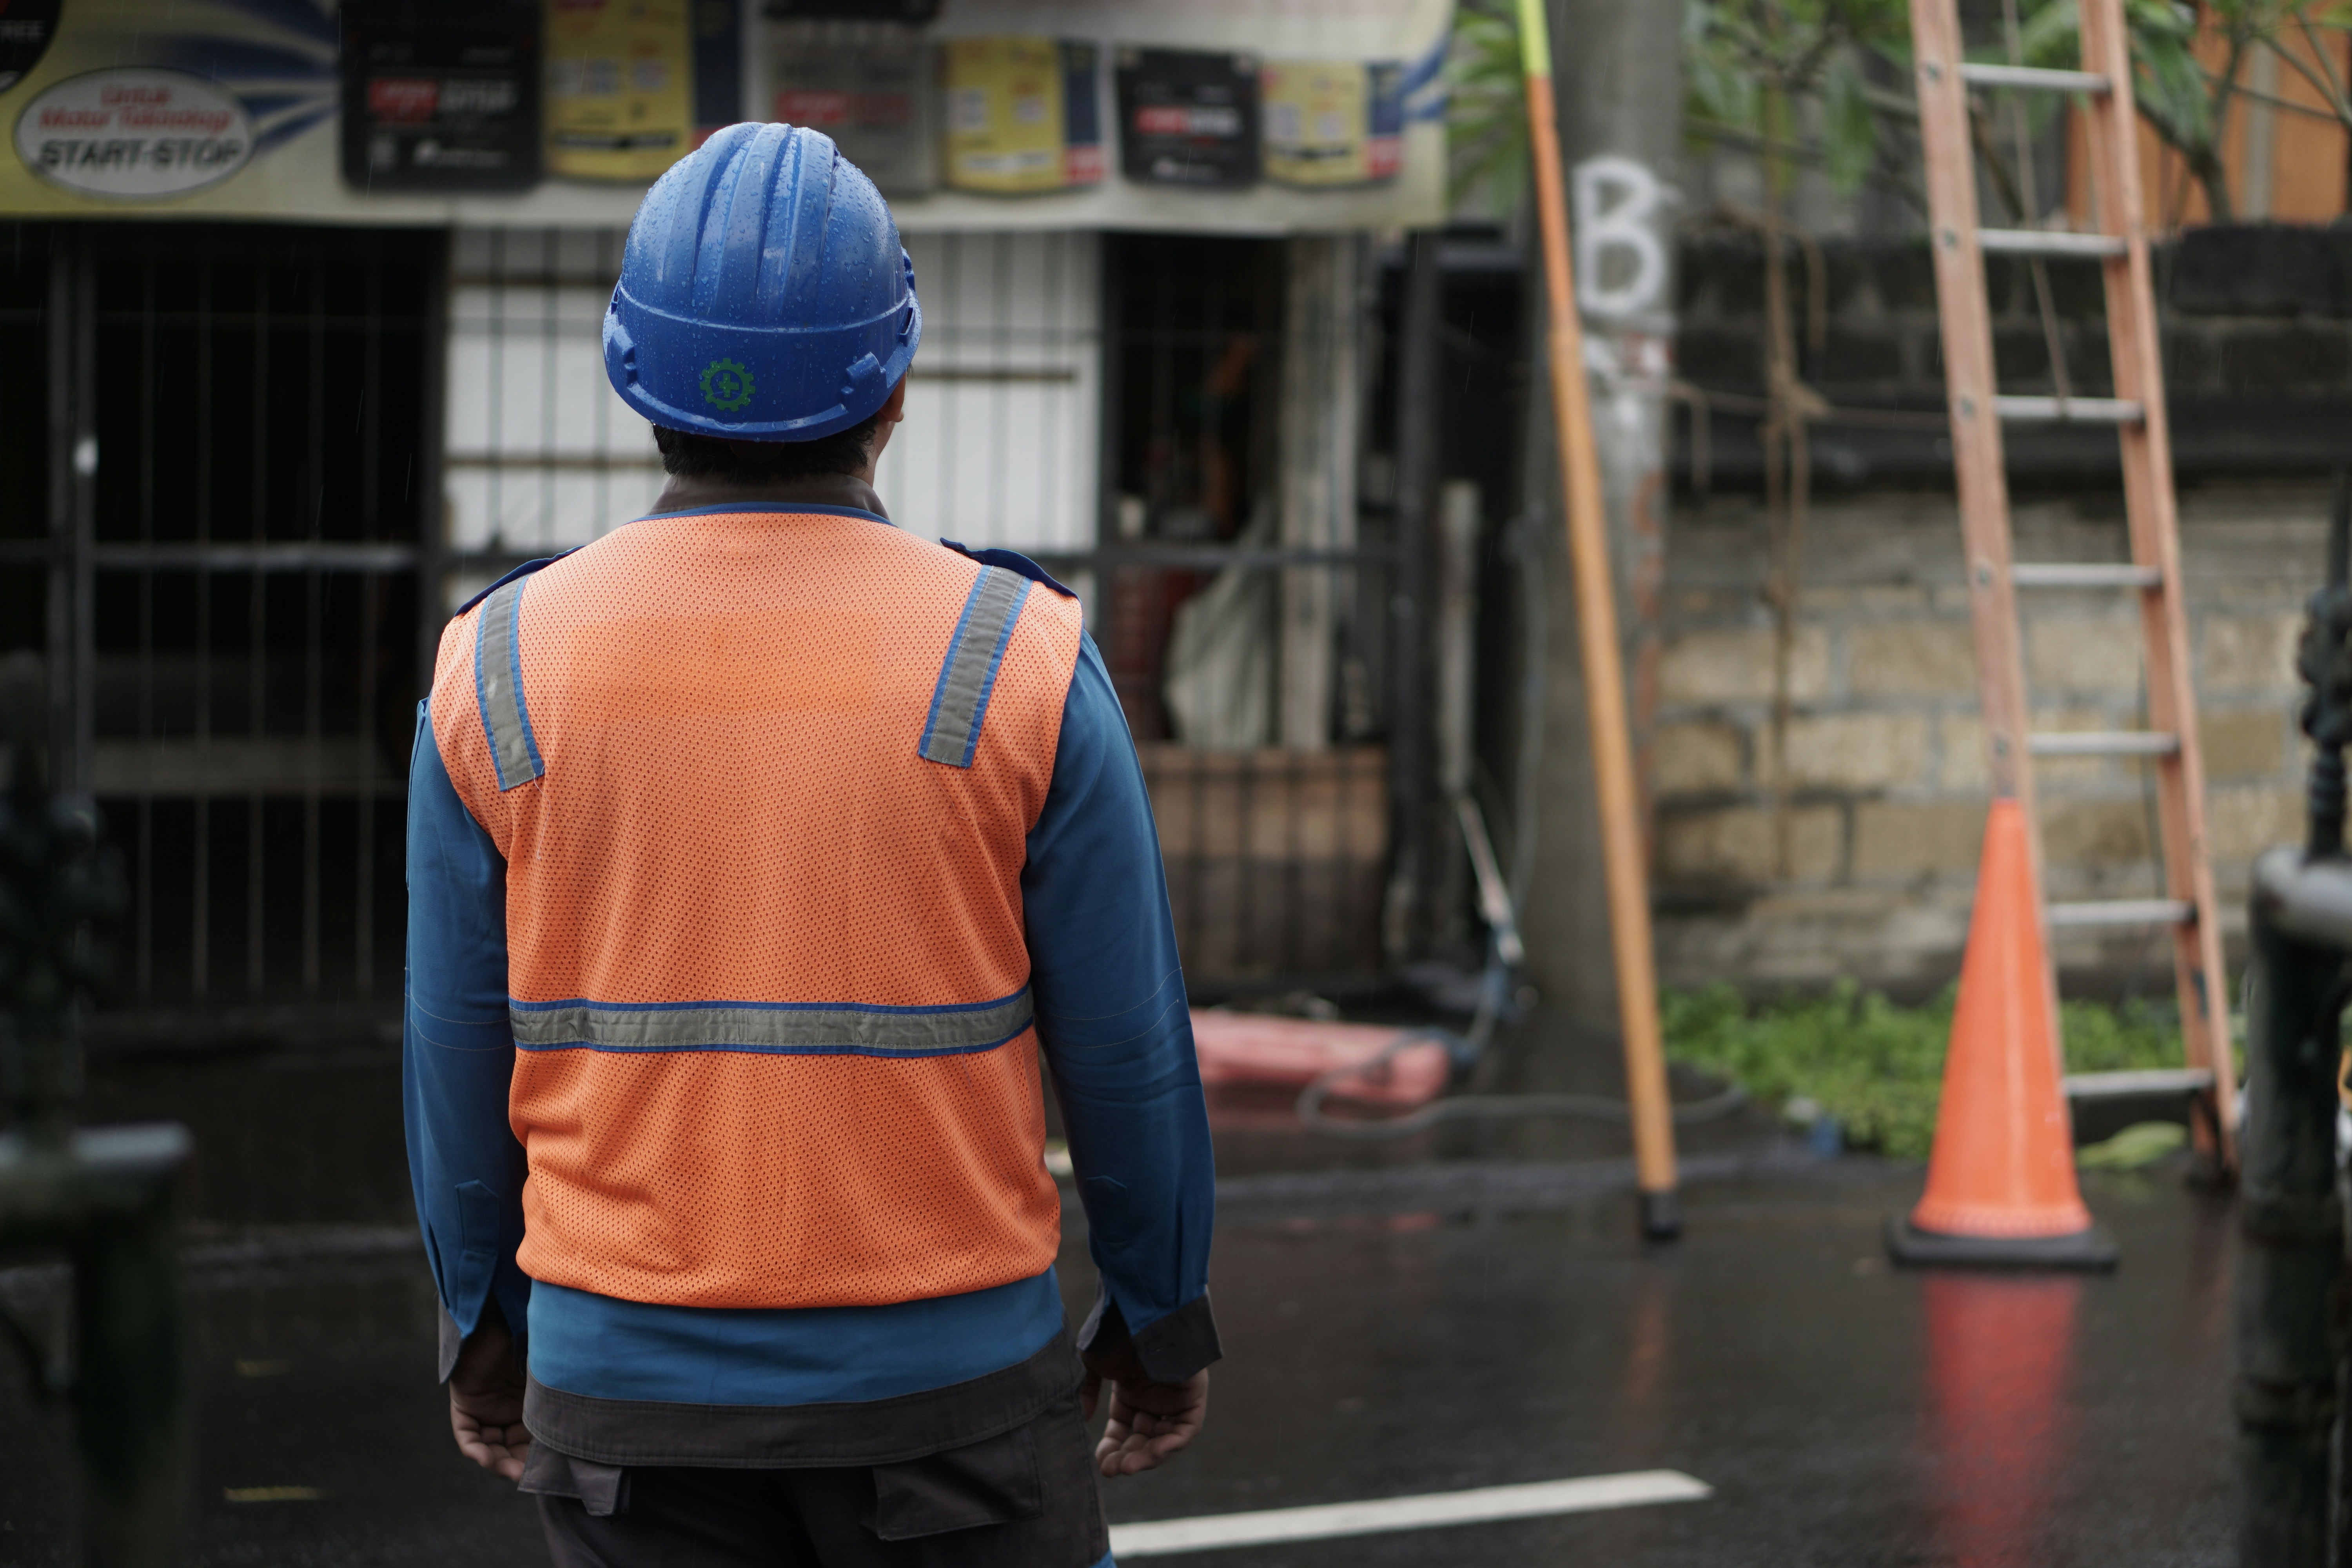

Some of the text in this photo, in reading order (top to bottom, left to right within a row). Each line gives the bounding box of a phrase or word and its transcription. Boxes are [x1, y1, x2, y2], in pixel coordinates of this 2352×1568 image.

[40, 106, 111, 129] Motor
[42, 138, 243, 169] START-STOP
[1573, 157, 1665, 314] B
